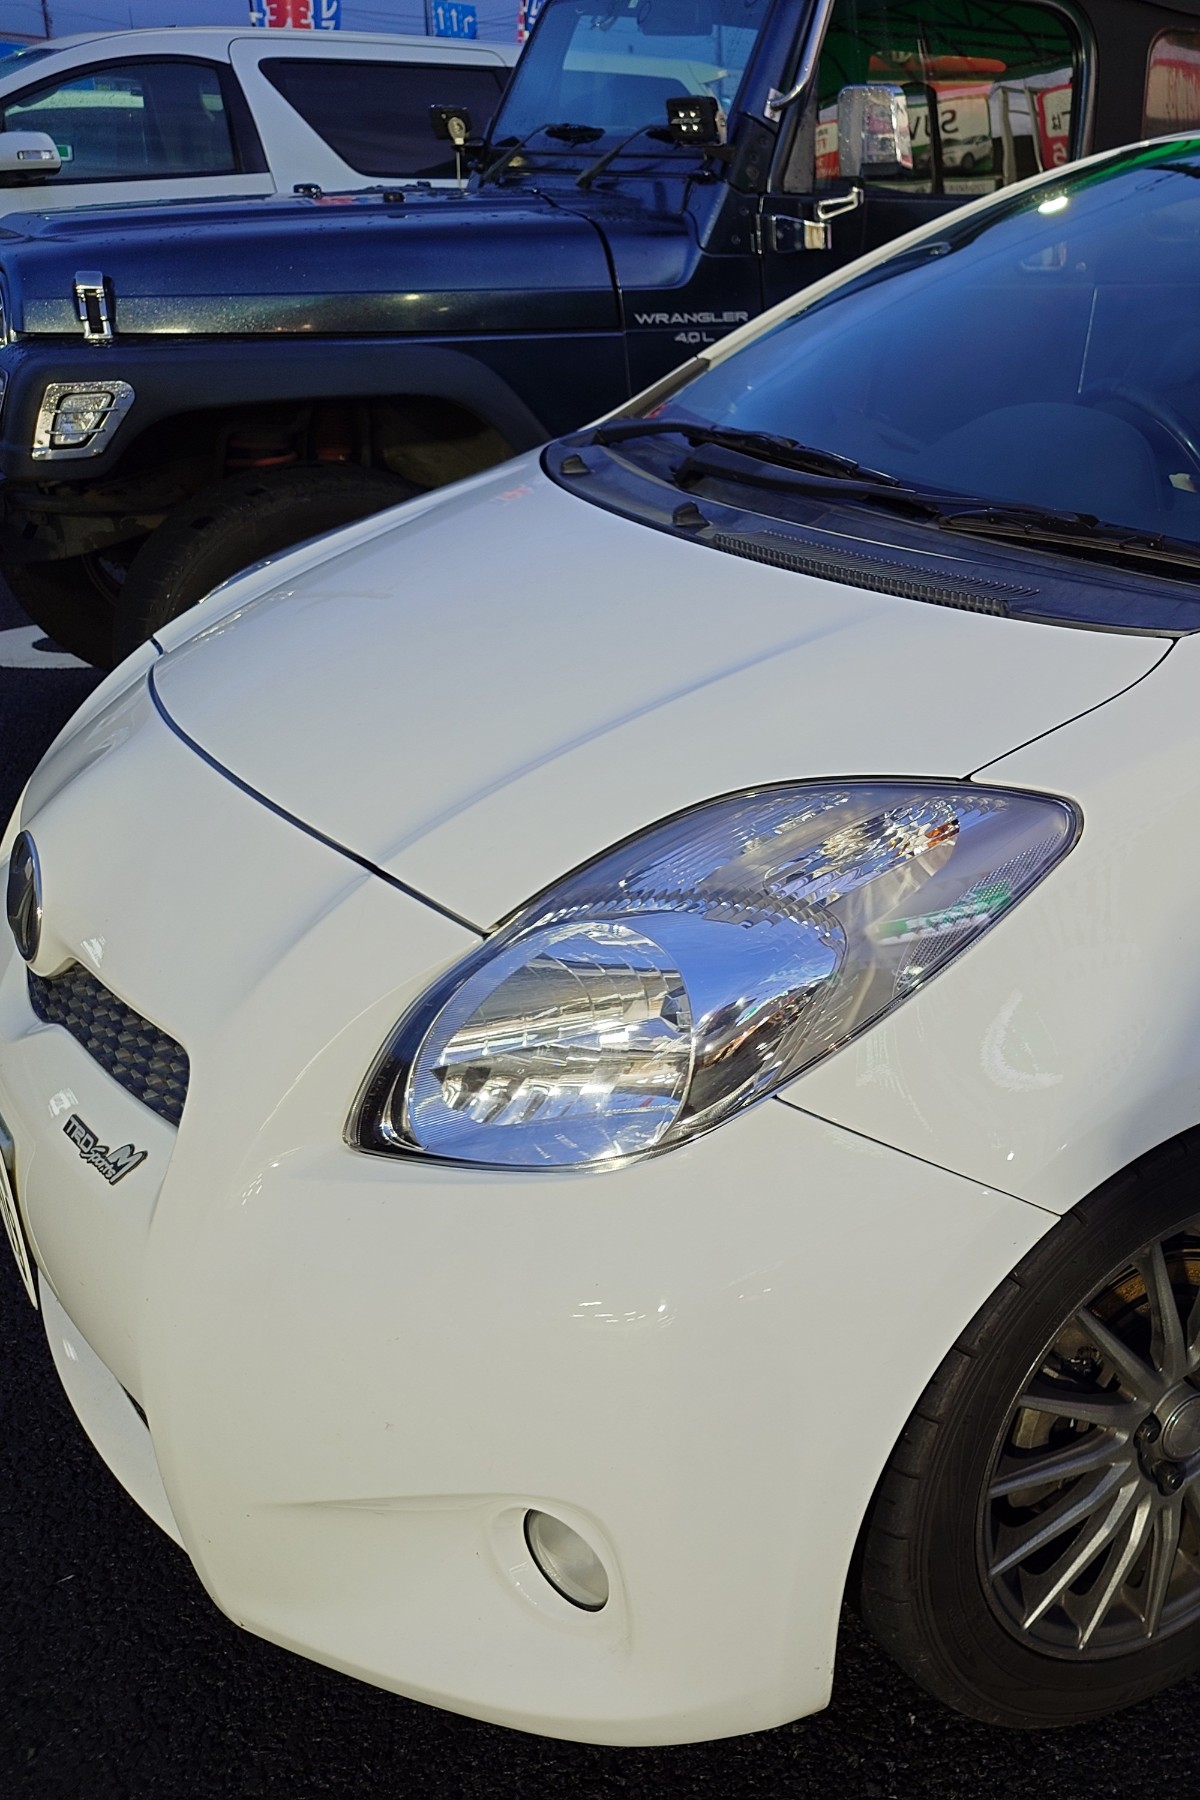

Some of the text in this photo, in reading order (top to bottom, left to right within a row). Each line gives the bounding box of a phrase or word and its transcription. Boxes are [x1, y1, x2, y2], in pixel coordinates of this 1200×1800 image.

[634, 311, 748, 325] WRANGLER
[66, 1115, 95, 1153] TRD
[81, 1146, 116, 1178] Sports
